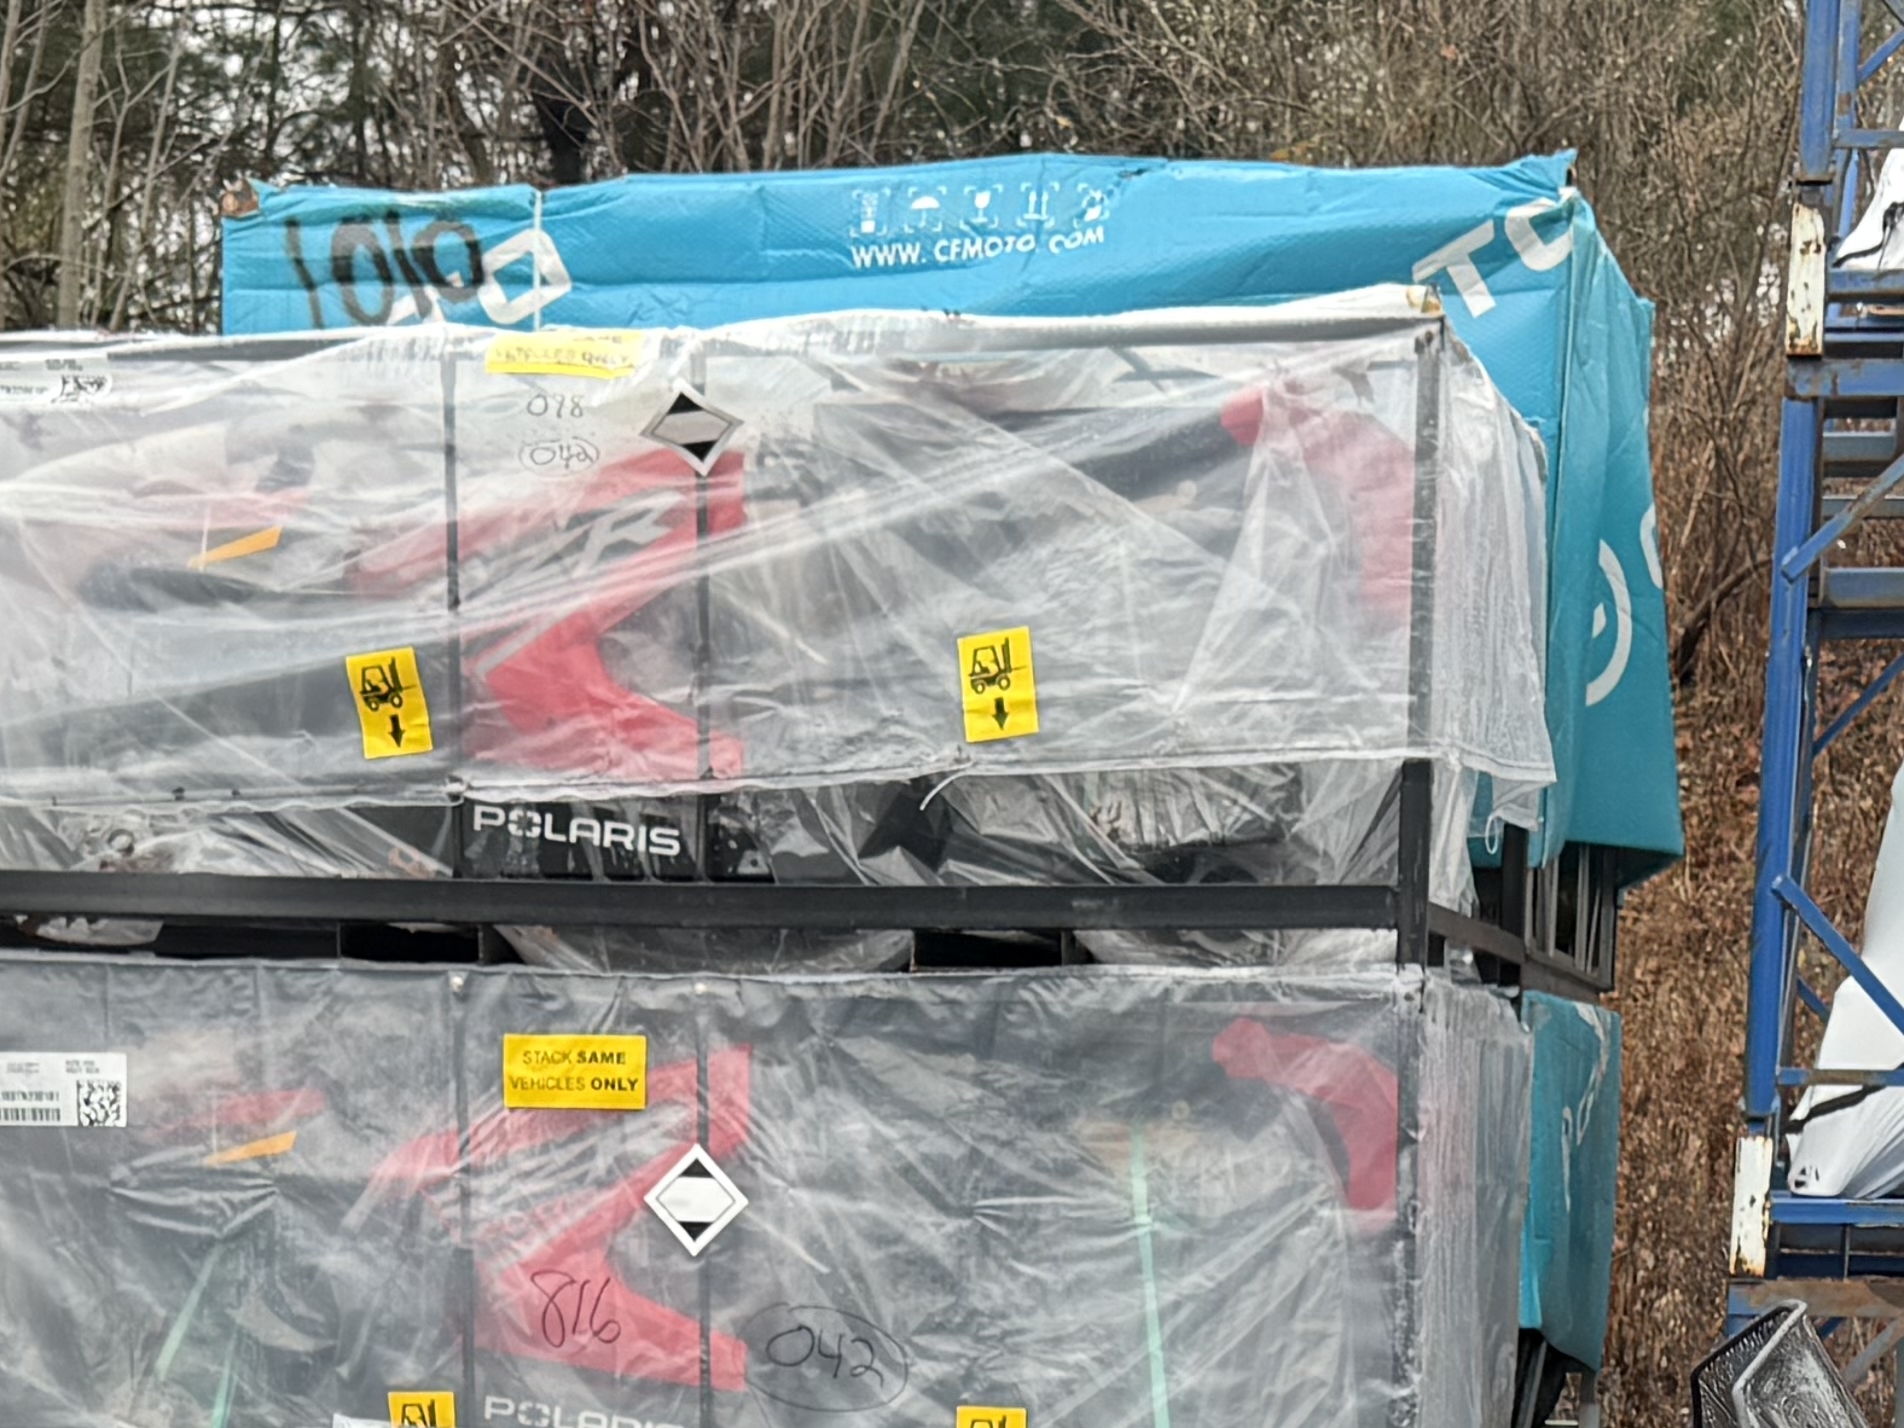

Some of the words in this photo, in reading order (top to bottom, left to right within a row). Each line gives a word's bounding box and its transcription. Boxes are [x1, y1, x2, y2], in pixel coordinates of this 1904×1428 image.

[473, 802, 683, 857] POLARIS
[522, 1048, 573, 1068] STACK
[576, 1049, 627, 1068] SAME
[590, 1075, 639, 1093] ONLY
